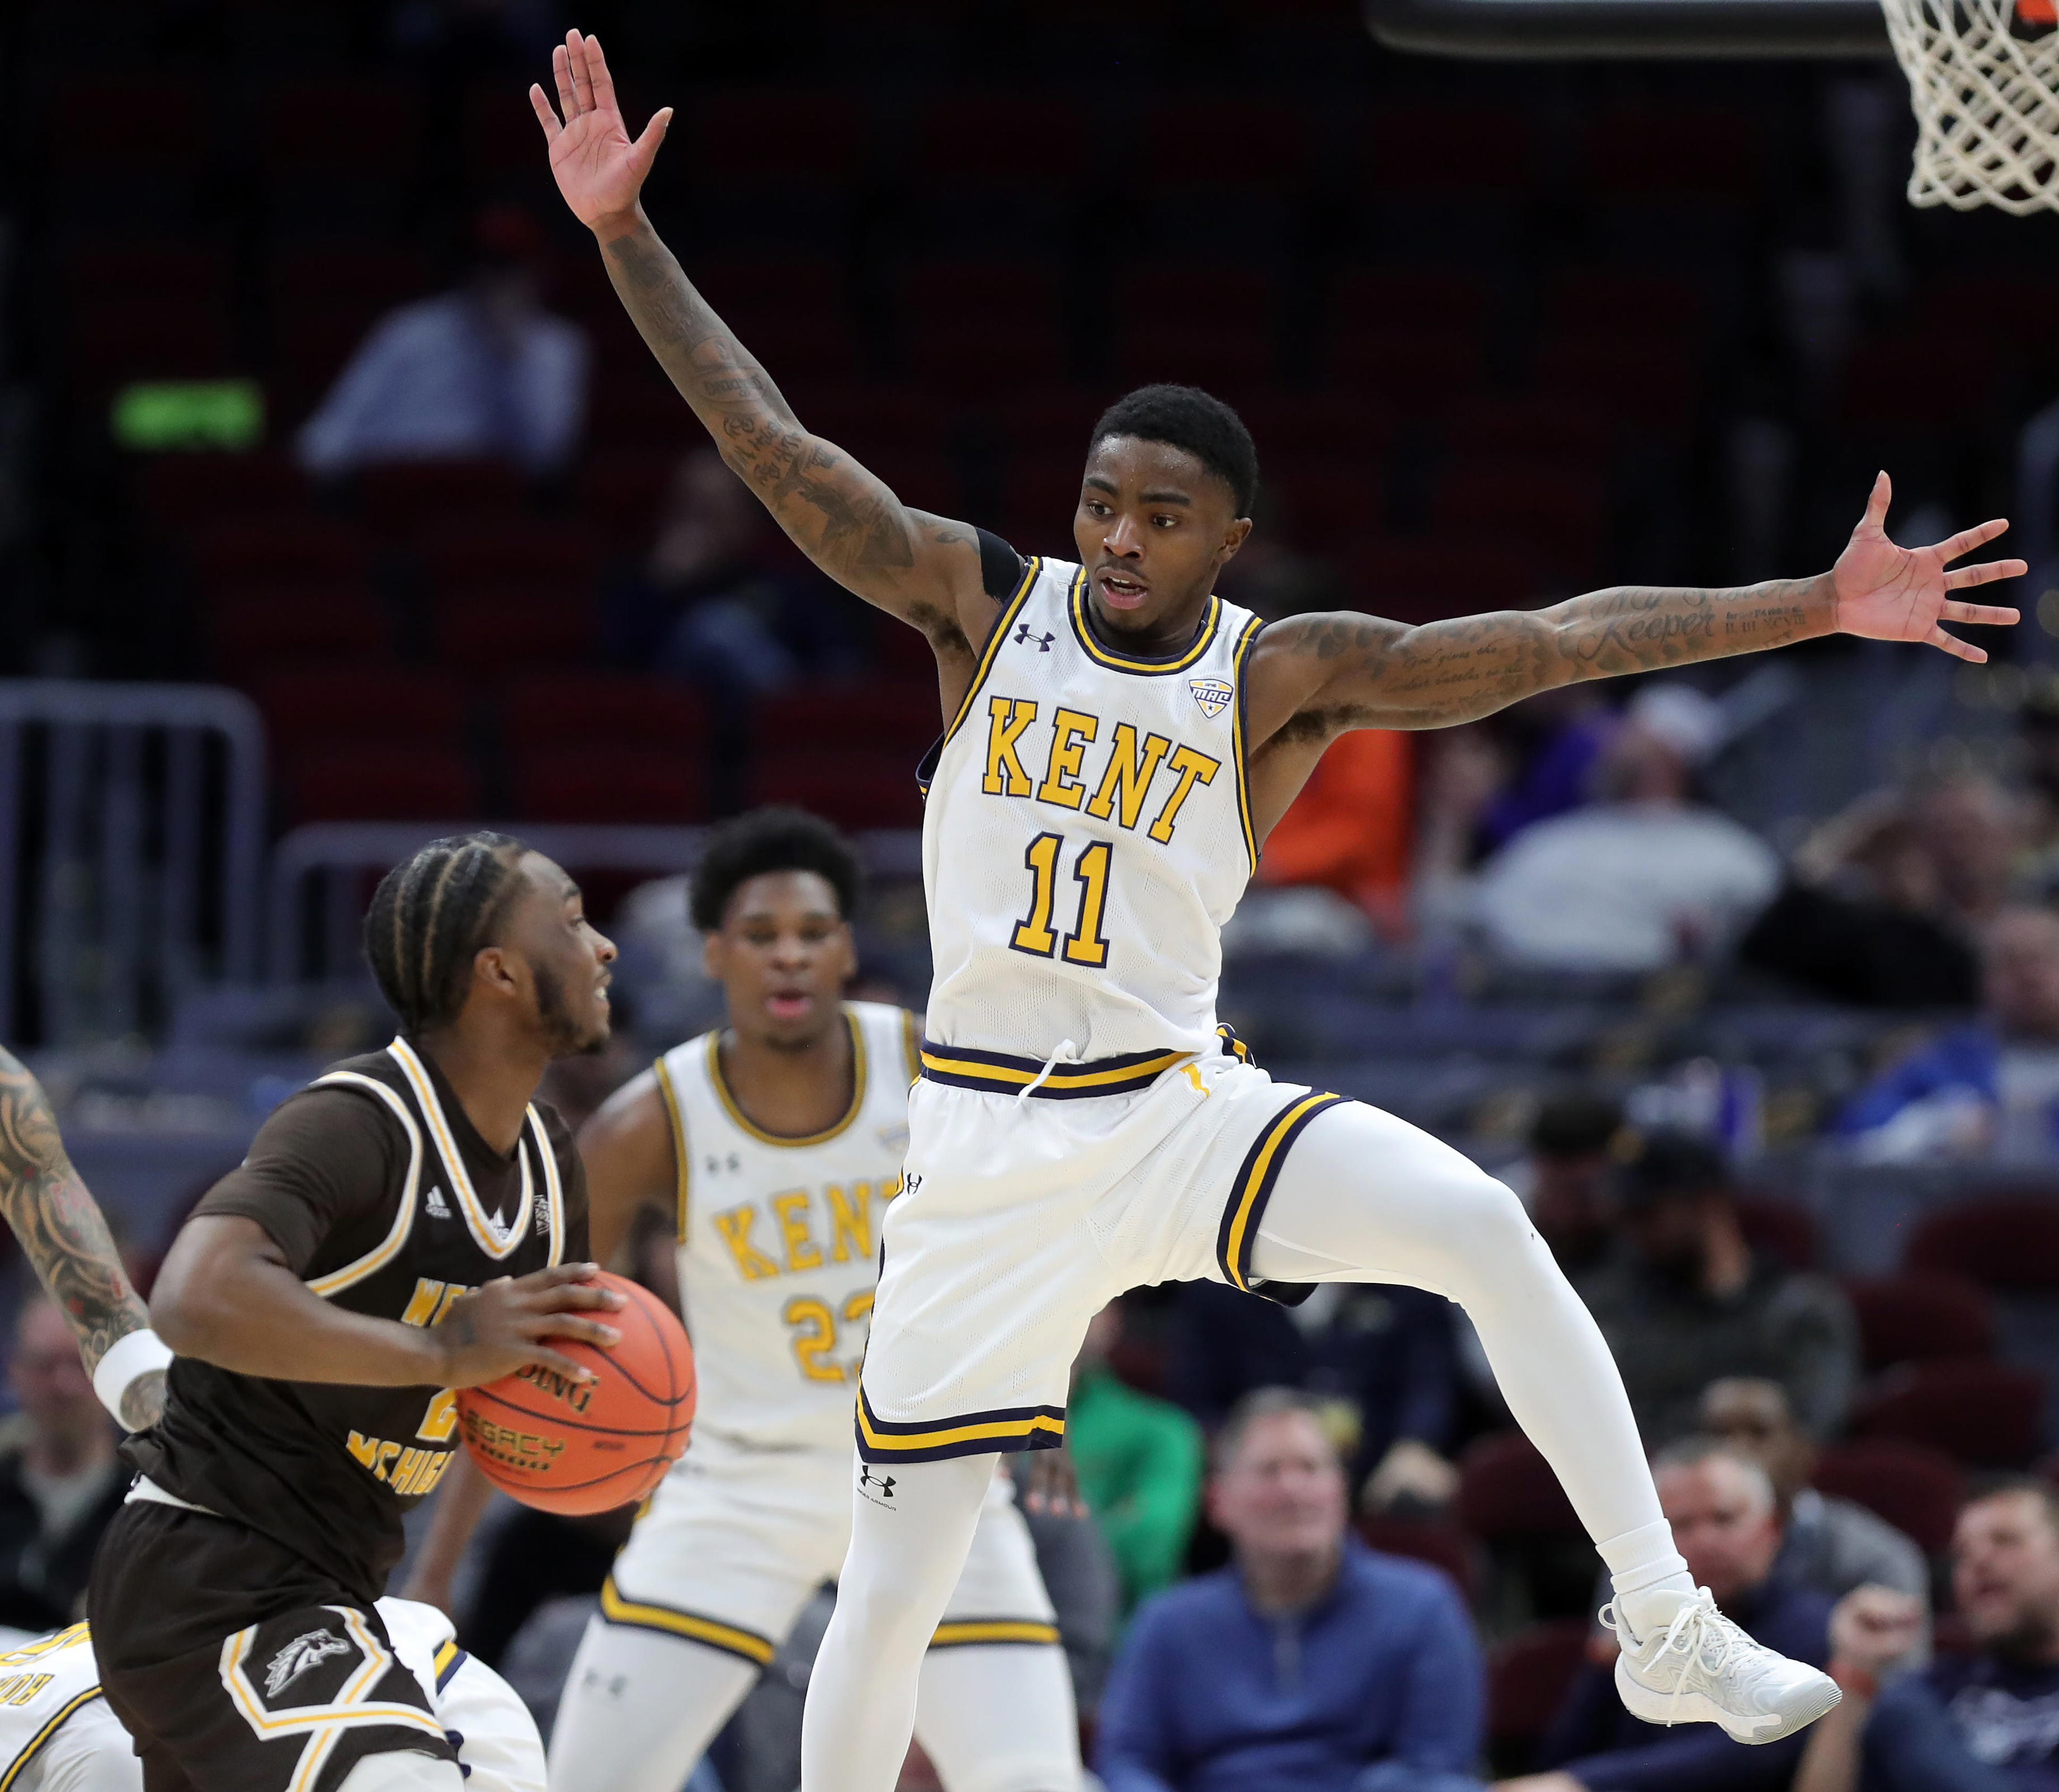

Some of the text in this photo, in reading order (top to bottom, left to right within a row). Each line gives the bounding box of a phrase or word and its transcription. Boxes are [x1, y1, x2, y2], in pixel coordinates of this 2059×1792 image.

[1191, 687, 1230, 703] MAC
[982, 696, 1222, 845] KENT
[1009, 831, 1113, 969] 11
[870, 1497, 897, 1512] ARMOUR
